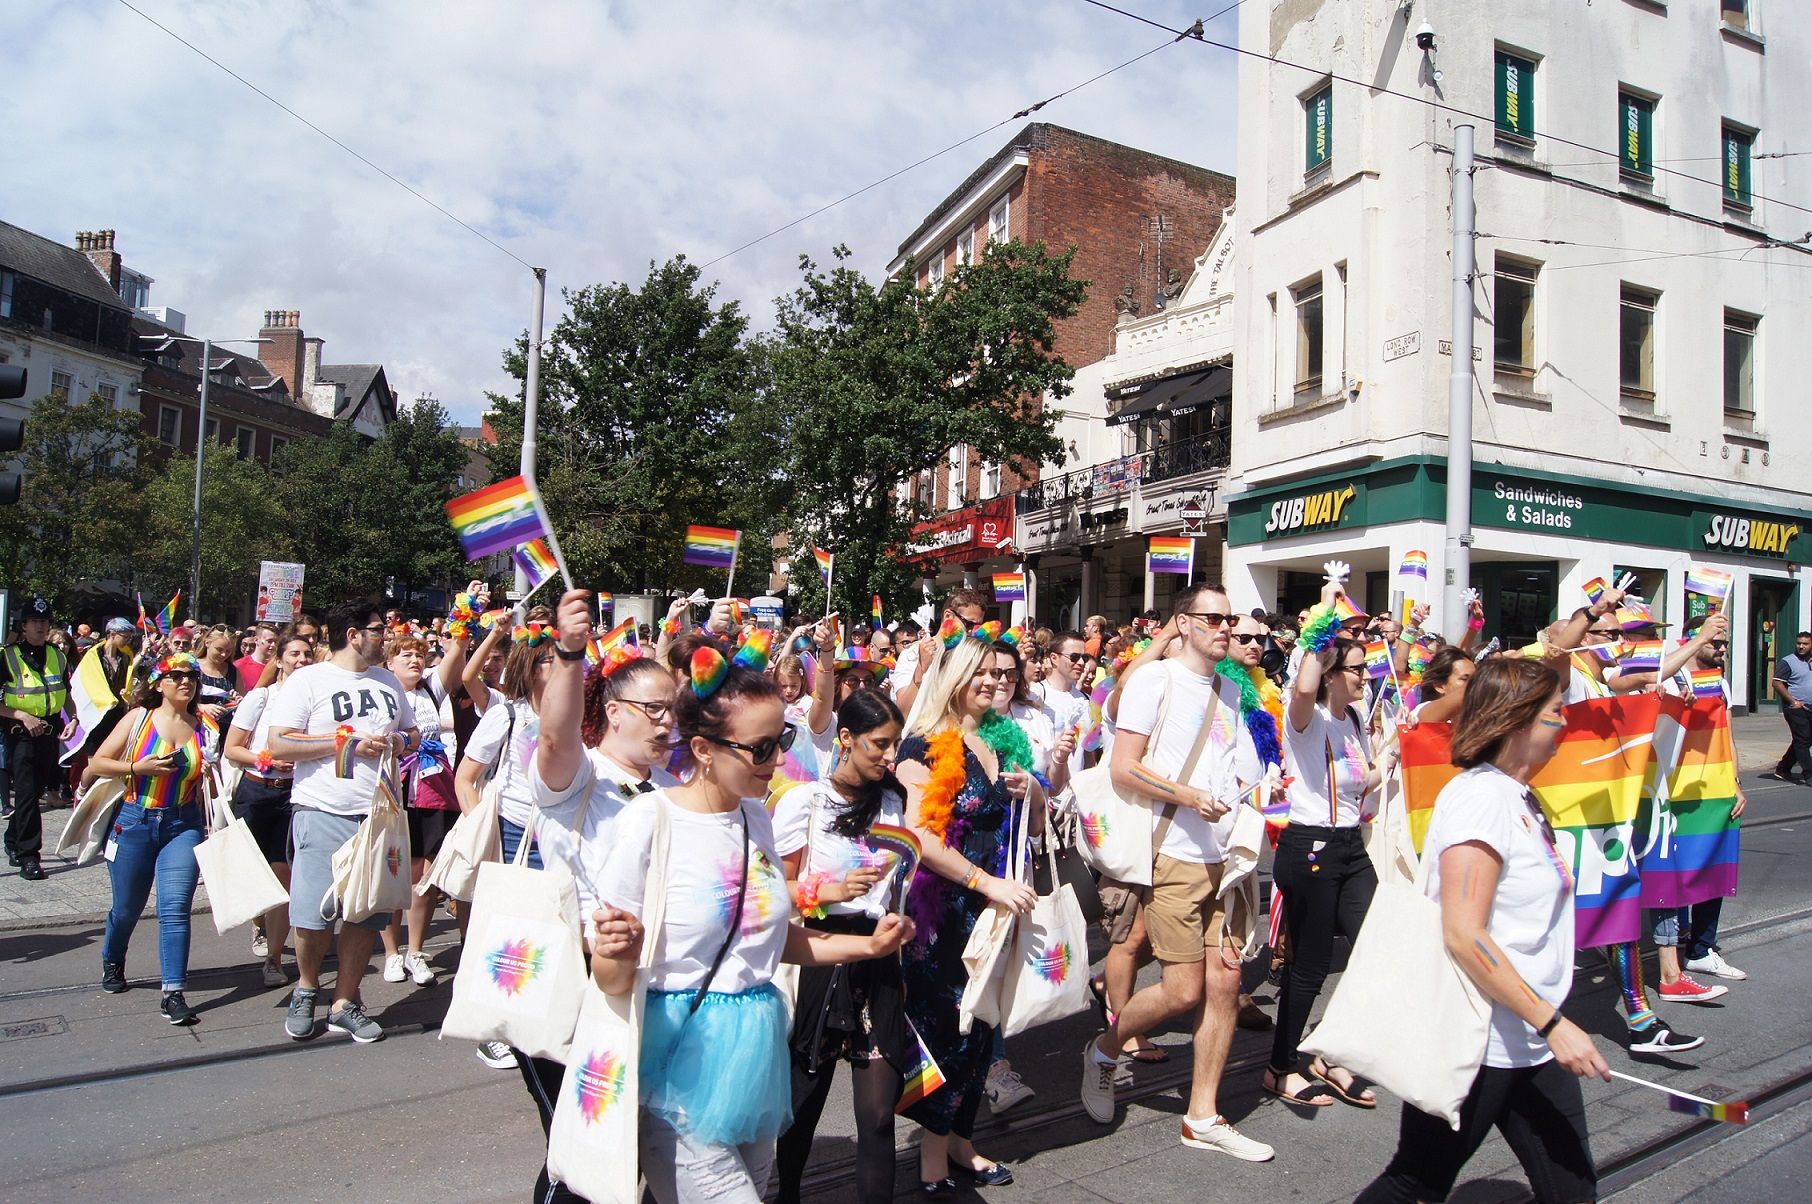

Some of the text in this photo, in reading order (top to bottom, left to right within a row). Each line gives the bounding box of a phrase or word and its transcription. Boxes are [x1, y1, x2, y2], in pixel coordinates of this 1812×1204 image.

[1506, 59, 1518, 132] SUBWAY
[1316, 96, 1326, 160] SUBWAY
[1628, 100, 1638, 168] SUBWAY
[1728, 134, 1738, 199] SUBWAY
[1213, 236, 1234, 274] TALBOT
[1393, 346, 1409, 357] WEST
[1404, 335, 1416, 346] ROW
[1265, 483, 1355, 533] SUBWAY
[1494, 481, 1583, 509] Sandwiches
[1506, 504, 1572, 528] & Salads
[1704, 515, 1799, 553] SUBWAY
[1692, 600, 1706, 609] Sub
[331, 689, 398, 722] GAP
[493, 956, 510, 965] COLOUR
[517, 961, 536, 970] PROUD
[592, 1077, 599, 1086] US
[599, 1079, 618, 1091] PROUD
